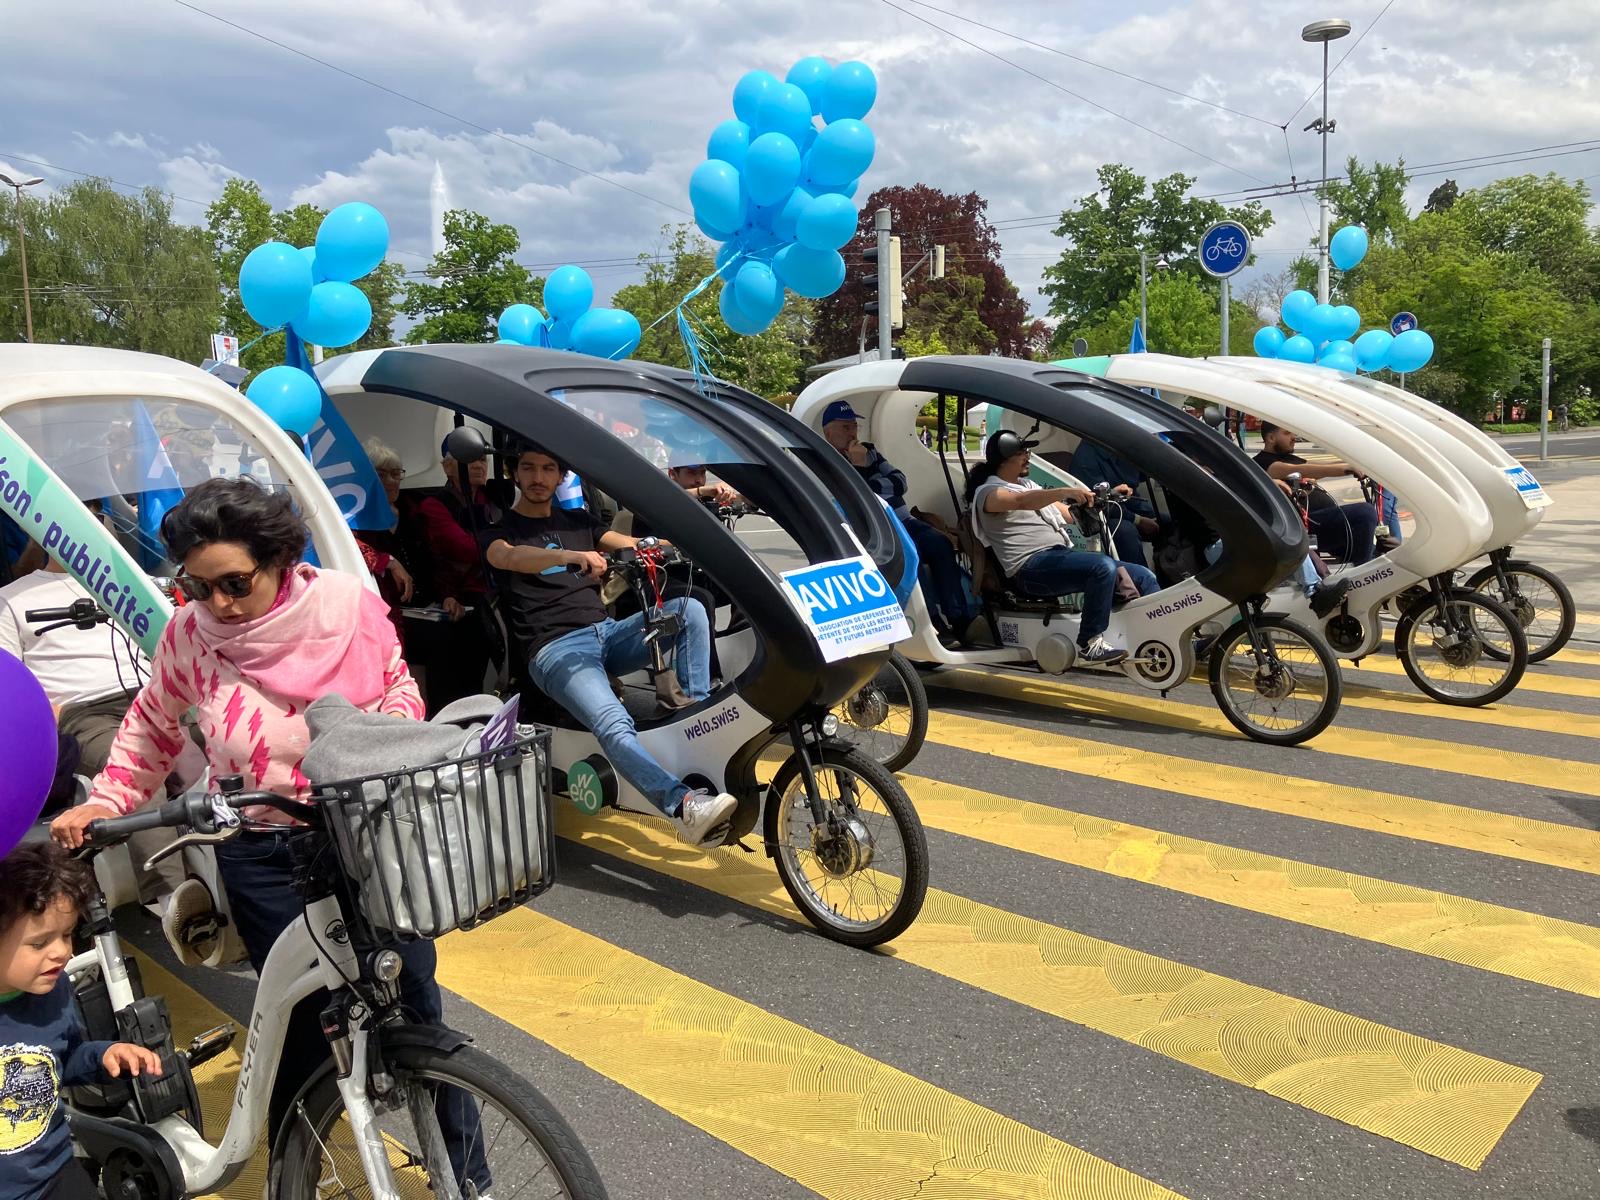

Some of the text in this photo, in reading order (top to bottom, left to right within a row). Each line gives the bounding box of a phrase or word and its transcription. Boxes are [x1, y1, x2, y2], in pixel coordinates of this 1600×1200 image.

[42, 520, 155, 639] publicité
[798, 568, 886, 614] AVIVO
[1347, 568, 1394, 591] elo.swiss
[853, 615, 862, 623] DE
[1146, 592, 1203, 620] welo.swiss
[844, 631, 865, 642] FUTURS
[851, 623, 866, 631] TOUS
[684, 706, 740, 741] welo.swiss
[236, 1011, 263, 1110] FLYER
